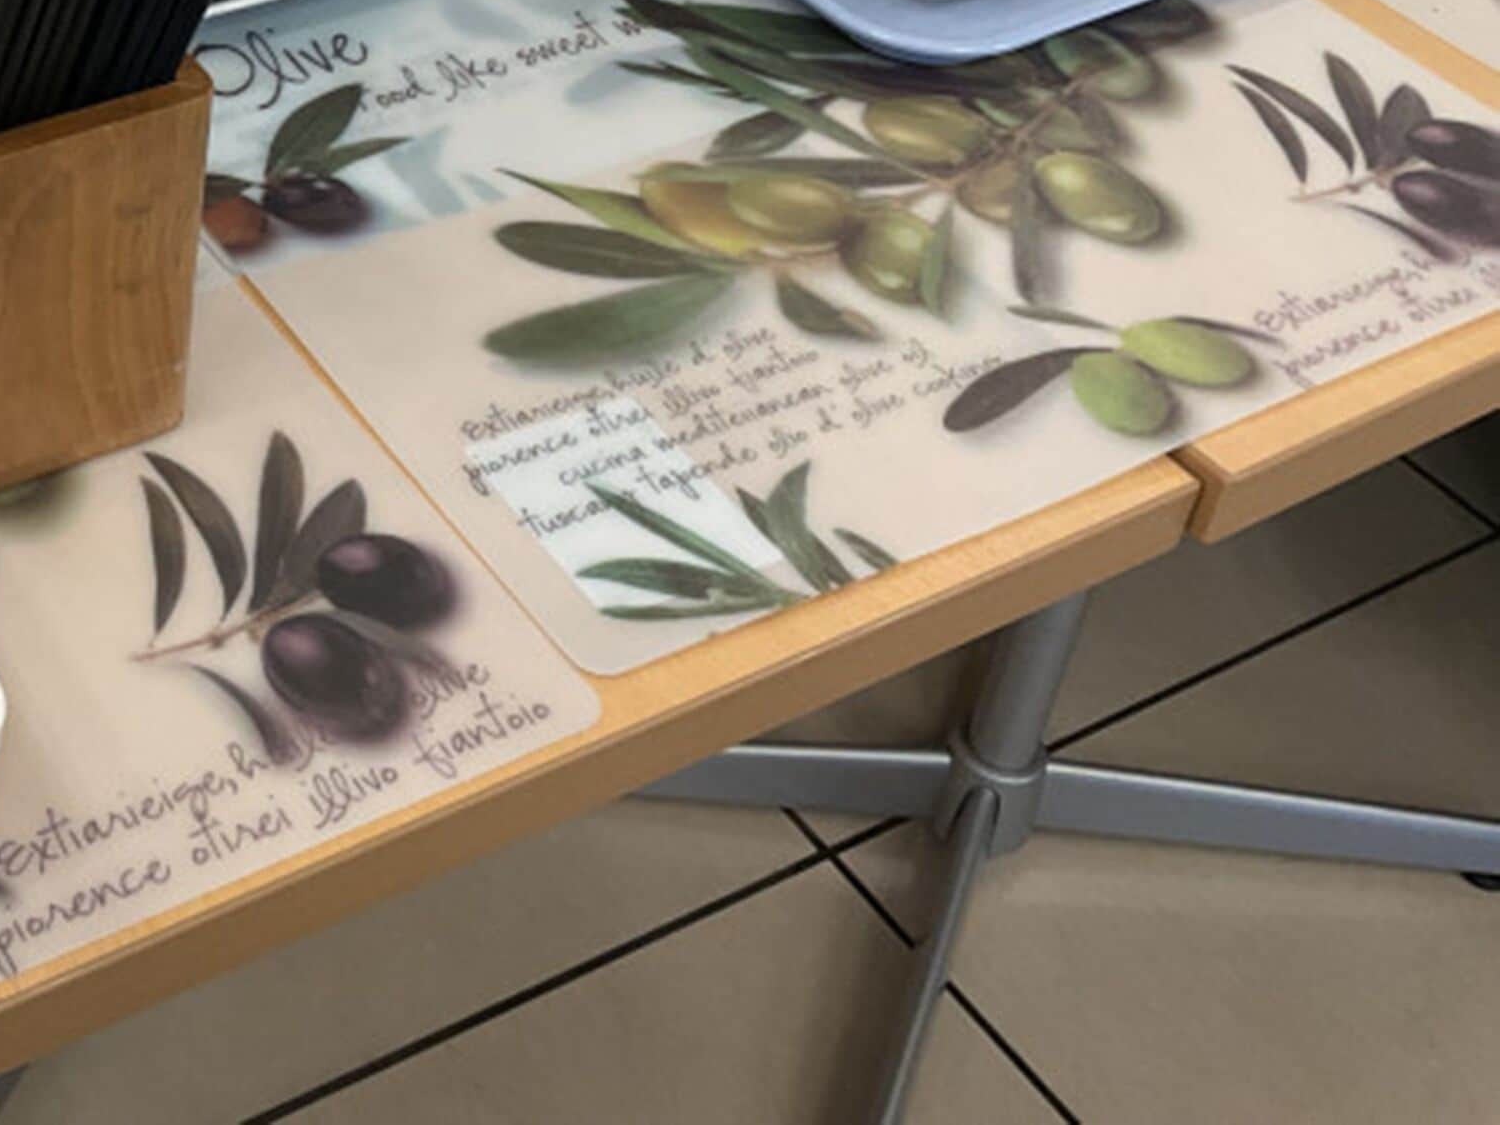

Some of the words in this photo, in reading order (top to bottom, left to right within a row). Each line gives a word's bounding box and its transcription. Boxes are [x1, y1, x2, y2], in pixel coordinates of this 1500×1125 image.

[192, 28, 369, 111] Olive
[358, 65, 434, 112] ood
[435, 52, 508, 103] like
[516, 9, 609, 67] sweet
